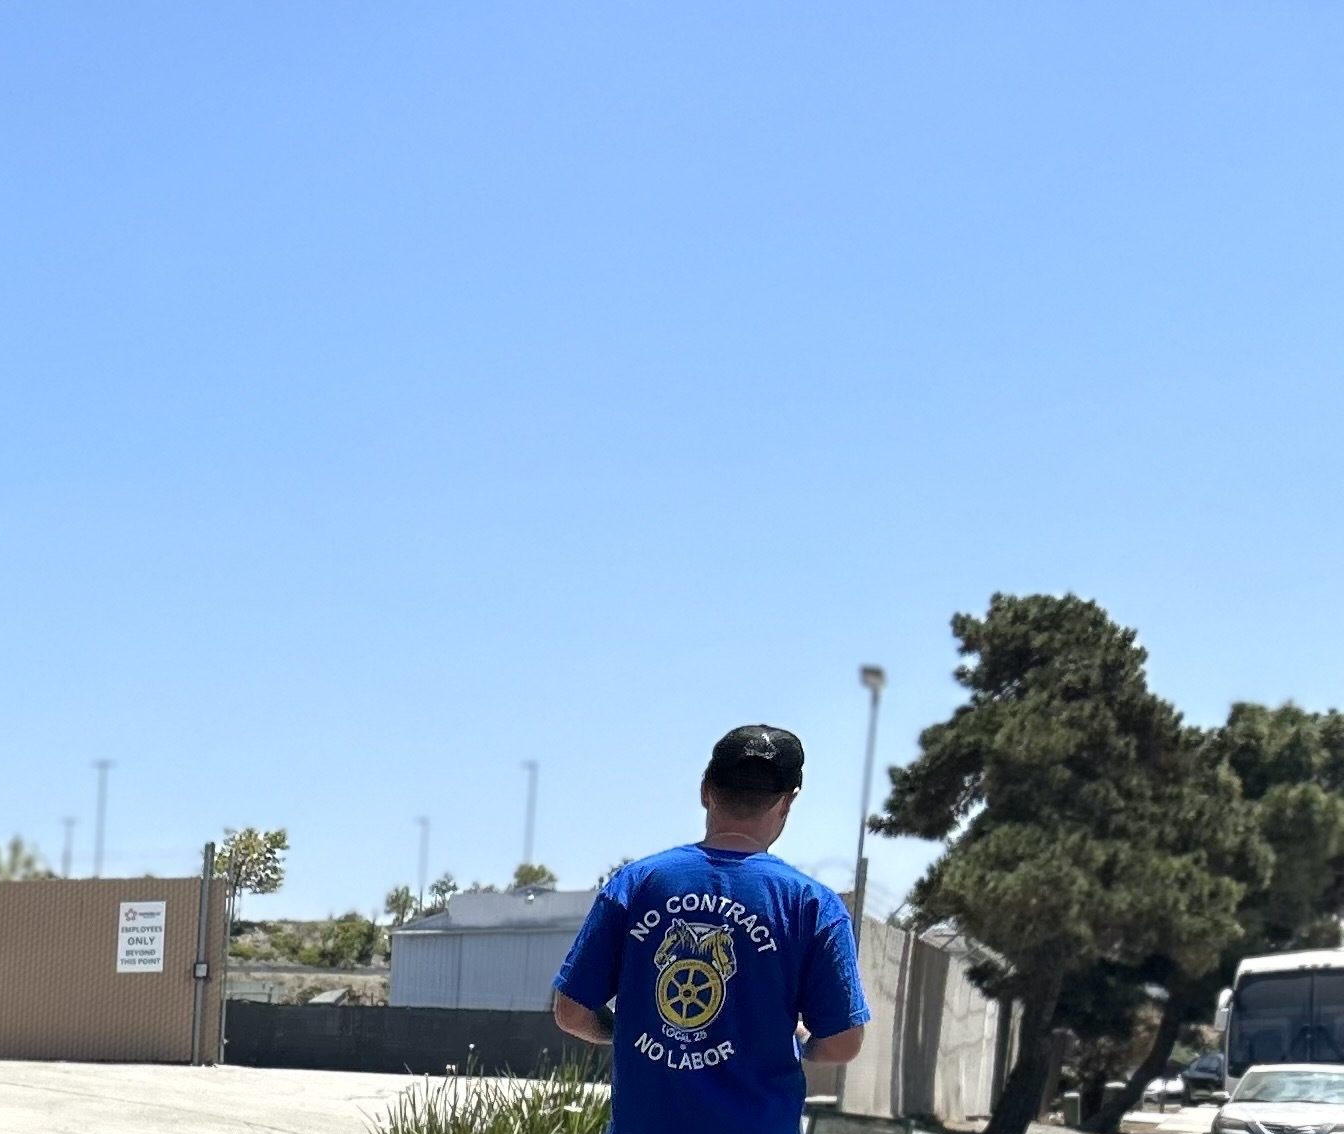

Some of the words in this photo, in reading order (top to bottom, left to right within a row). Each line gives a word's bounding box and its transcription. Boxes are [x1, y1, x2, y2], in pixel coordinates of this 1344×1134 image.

[630, 909, 660, 942] NO
[666, 893, 777, 954] CONTRACT
[127, 936, 156, 946] ONLY
[125, 949, 156, 957] BEYOND
[138, 957, 161, 965] POINT
[662, 1023, 691, 1042] LOCAL
[634, 1032, 664, 1061] NO
[668, 1040, 736, 1070] LABOR
